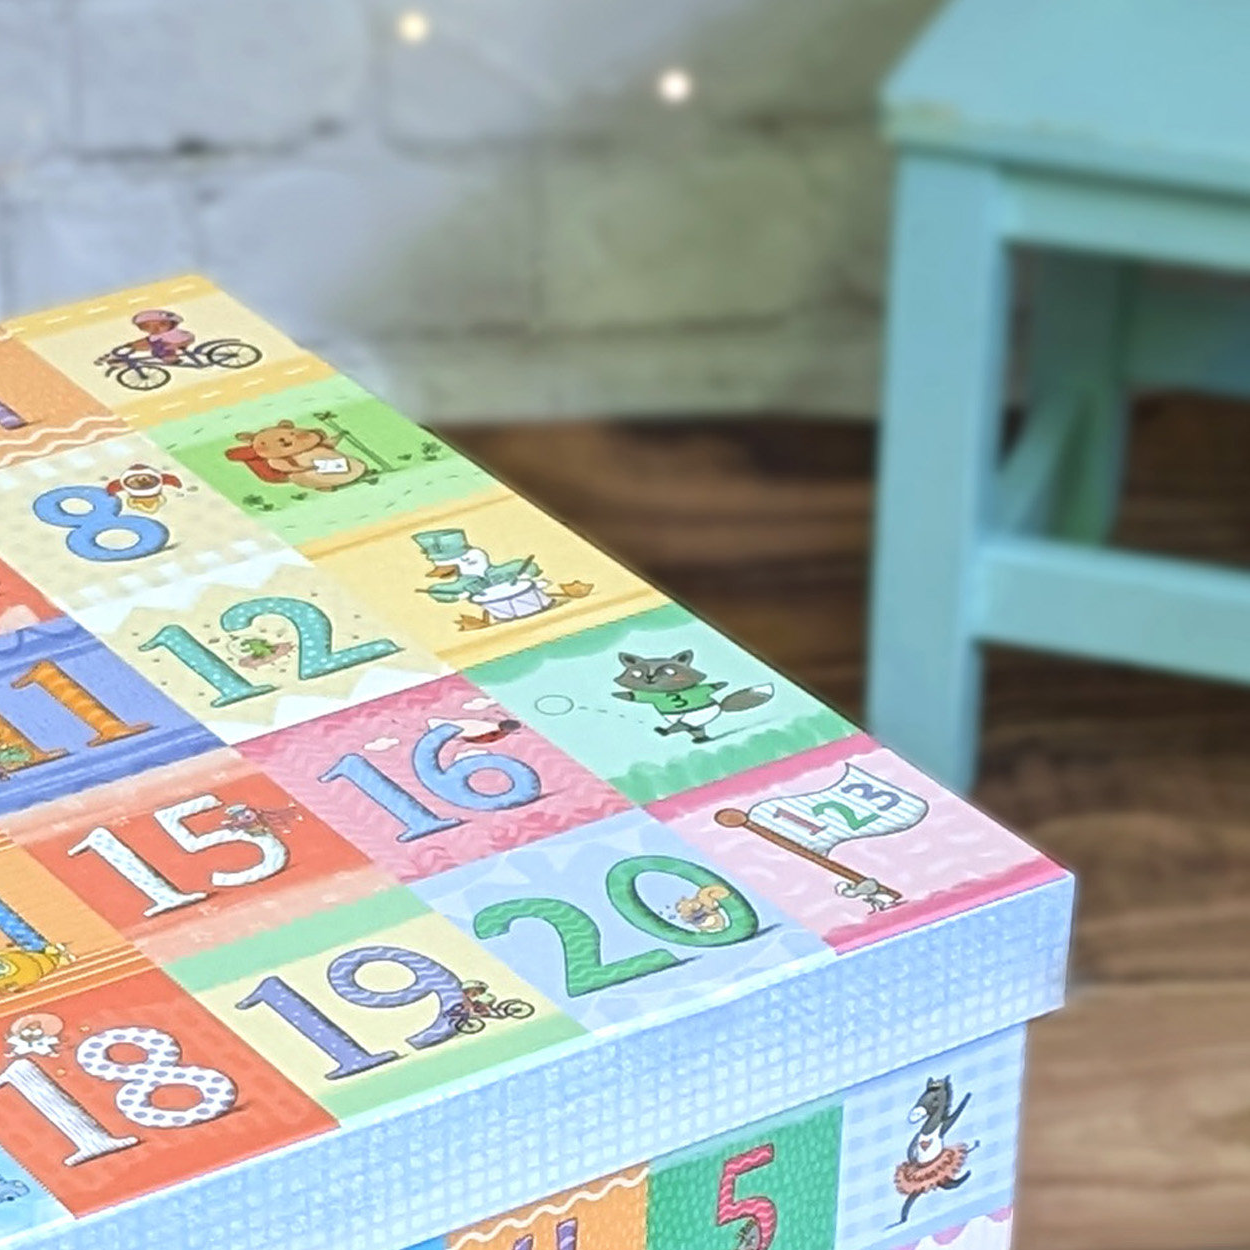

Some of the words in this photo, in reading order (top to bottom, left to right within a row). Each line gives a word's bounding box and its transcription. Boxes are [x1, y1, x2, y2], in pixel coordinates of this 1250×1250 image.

[33, 485, 170, 561] 8
[138, 597, 398, 706] 12
[665, 692, 688, 708] 3
[318, 724, 541, 842] 16
[68, 794, 290, 917] 15
[474, 856, 758, 997] 20
[236, 946, 464, 1079] 19
